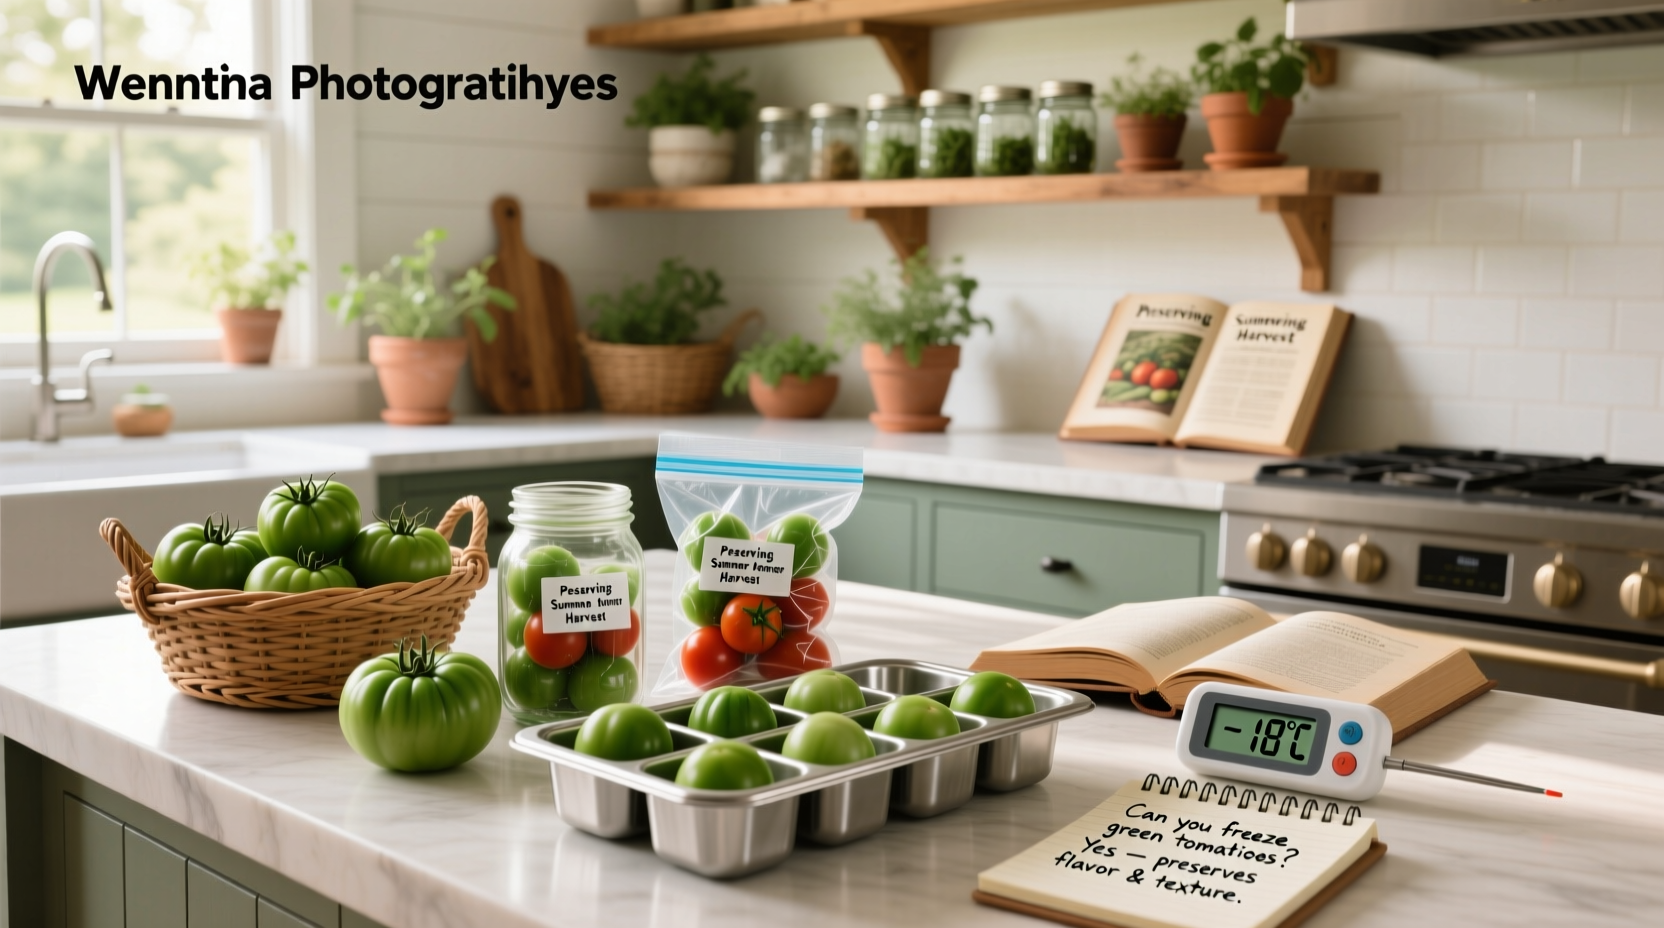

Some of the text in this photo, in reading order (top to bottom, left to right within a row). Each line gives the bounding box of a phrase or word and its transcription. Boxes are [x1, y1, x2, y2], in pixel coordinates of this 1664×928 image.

[565, 611, 606, 624] Harvest
[1102, 823, 1163, 842] green
[1125, 803, 1288, 847] Can you freeze
[1054, 851, 1242, 904] flavor & texture.
[1081, 836, 1117, 857] Yes
[1152, 856, 1258, 884] preserves
